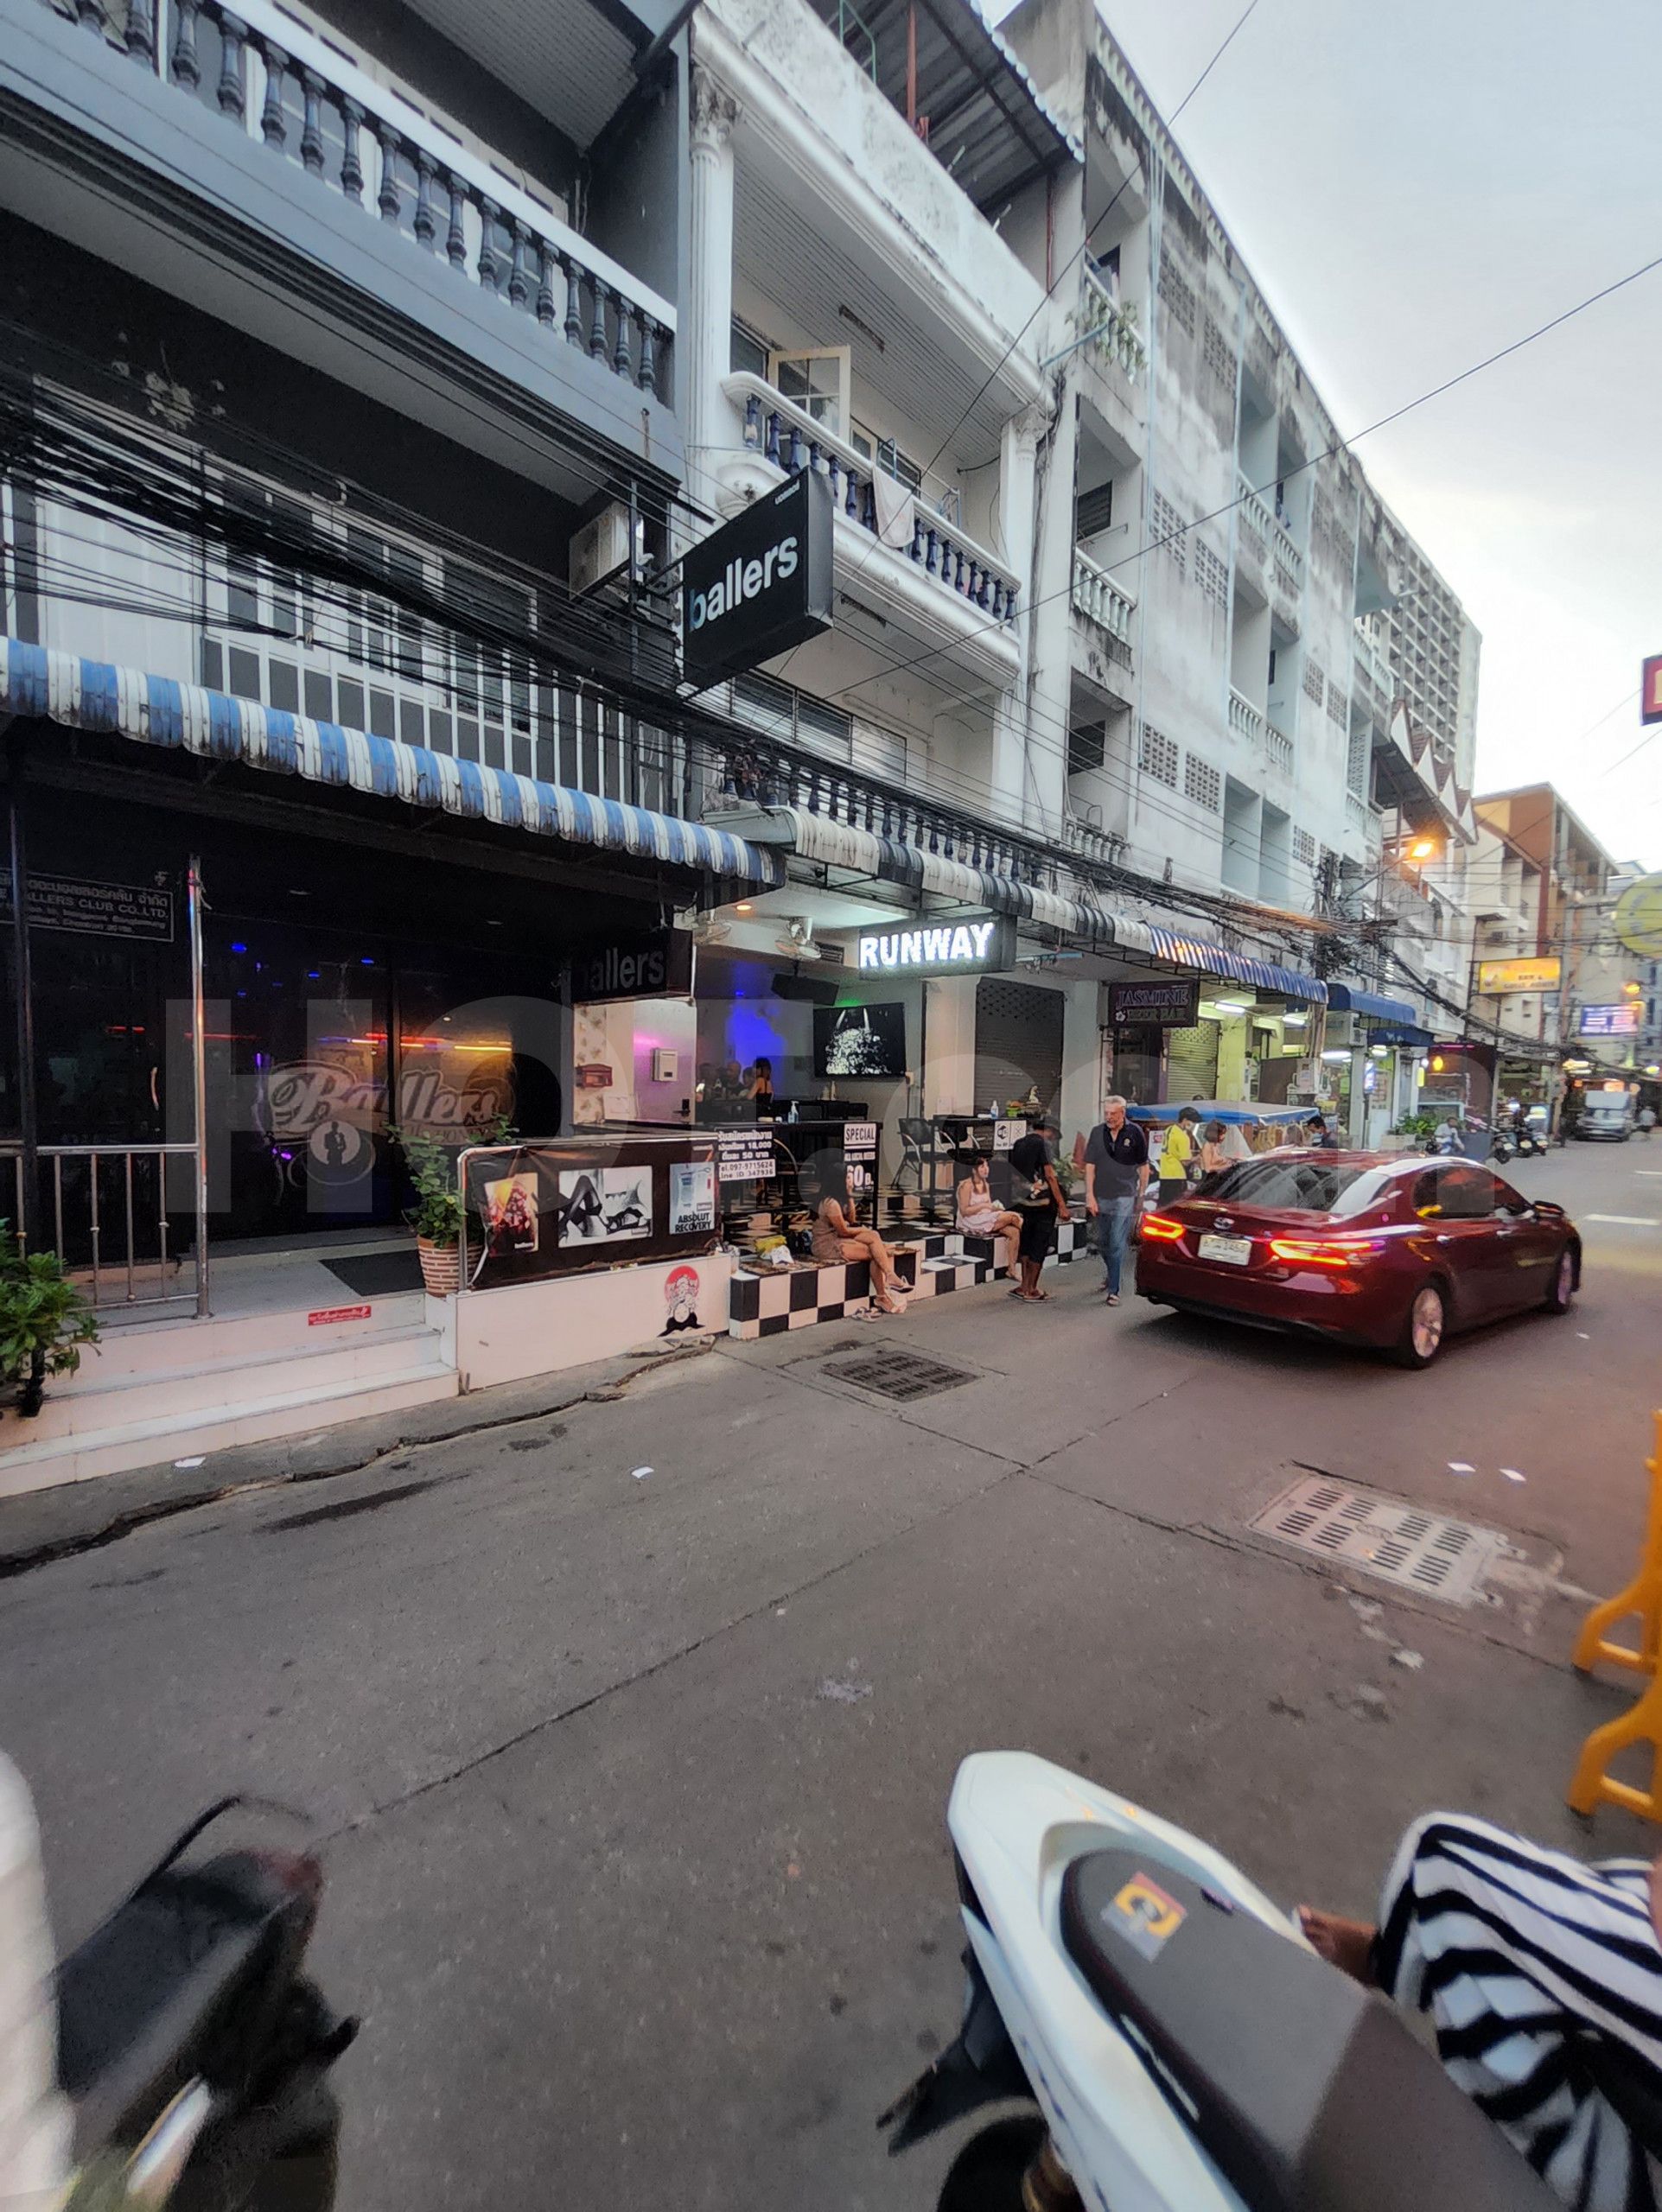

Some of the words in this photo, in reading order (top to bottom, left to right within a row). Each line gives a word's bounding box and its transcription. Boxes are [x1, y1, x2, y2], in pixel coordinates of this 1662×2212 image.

[690, 537, 798, 632] ballers
[28, 892, 75, 906] LLERS
[79, 899, 115, 912] CLUB
[860, 922, 994, 969] RUNWAY
[1115, 988, 1188, 1010] JASMINE
[270, 1064, 500, 1130] Ballers
[845, 1127, 875, 1141] SPECIAL
[742, 1151, 753, 1160] 50
[675, 1220, 712, 1233] RECOVERY
[678, 1212, 710, 1224] ABSOLUT
